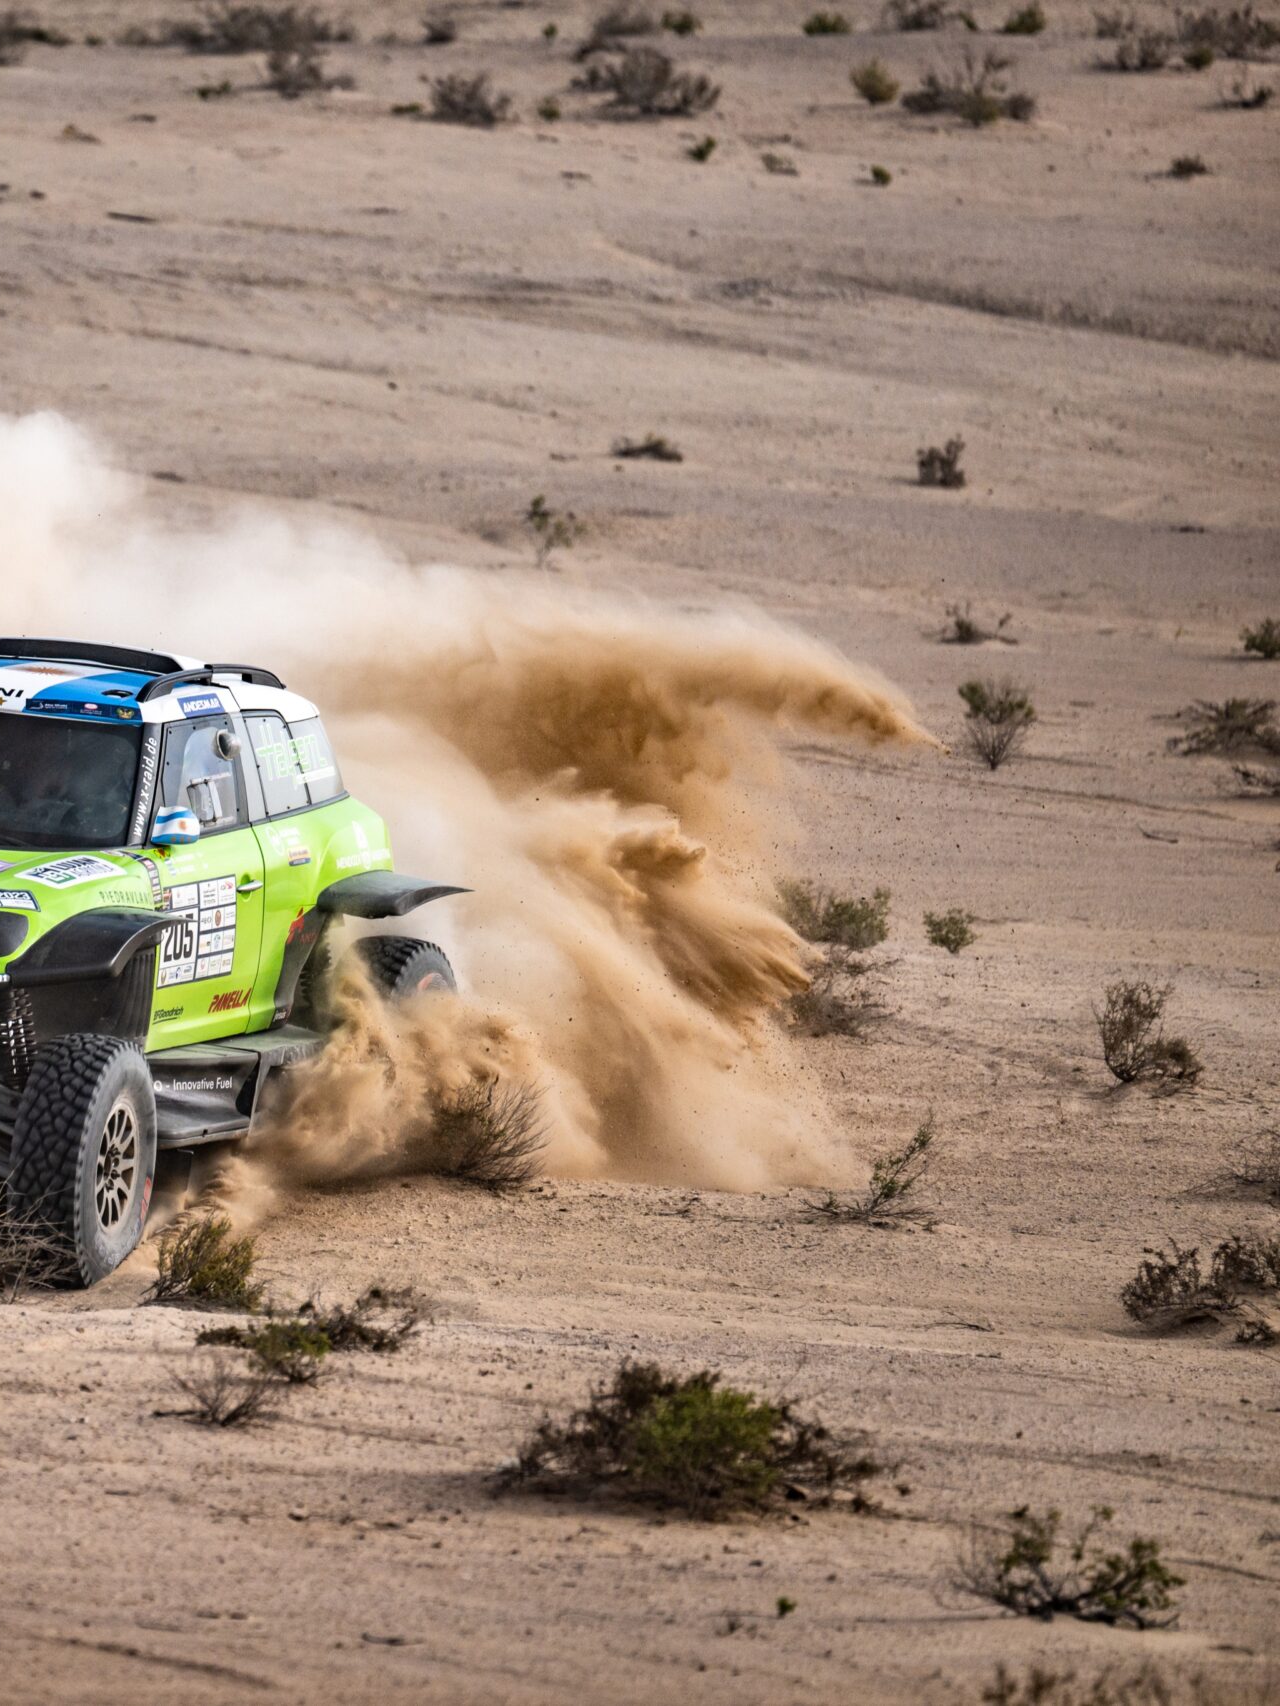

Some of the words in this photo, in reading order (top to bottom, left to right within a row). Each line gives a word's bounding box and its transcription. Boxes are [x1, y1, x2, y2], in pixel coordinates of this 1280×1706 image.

[133, 737, 158, 838] www.x-raid.de
[163, 912, 194, 963] 205
[173, 1077, 214, 1092] Innovative
[216, 1076, 233, 1090] Fuel
